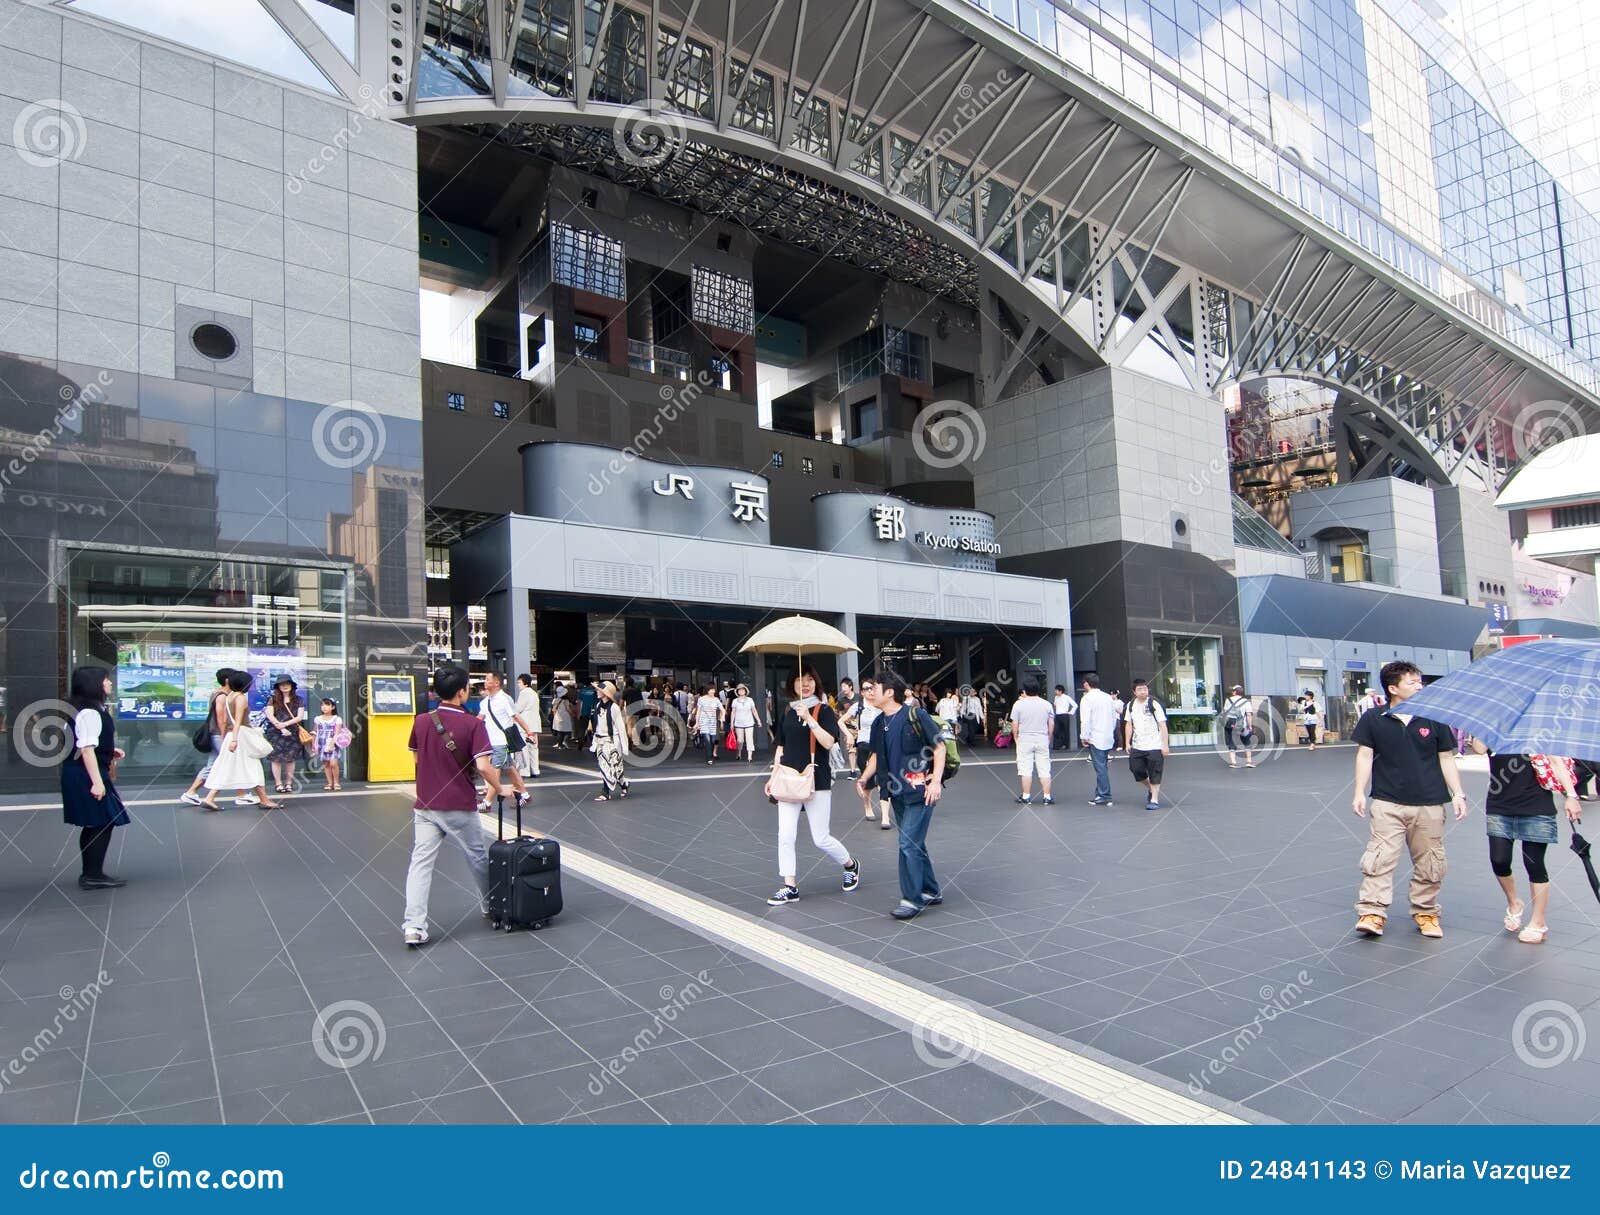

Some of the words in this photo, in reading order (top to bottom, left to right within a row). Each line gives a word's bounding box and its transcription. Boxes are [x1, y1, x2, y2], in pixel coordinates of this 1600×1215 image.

[652, 472, 694, 500] JR
[730, 481, 768, 522] 京
[872, 503, 907, 541] 都
[924, 531, 958, 549] Kyoto
[961, 536, 1001, 554] Station
[119, 698, 165, 714] 夏の旅
